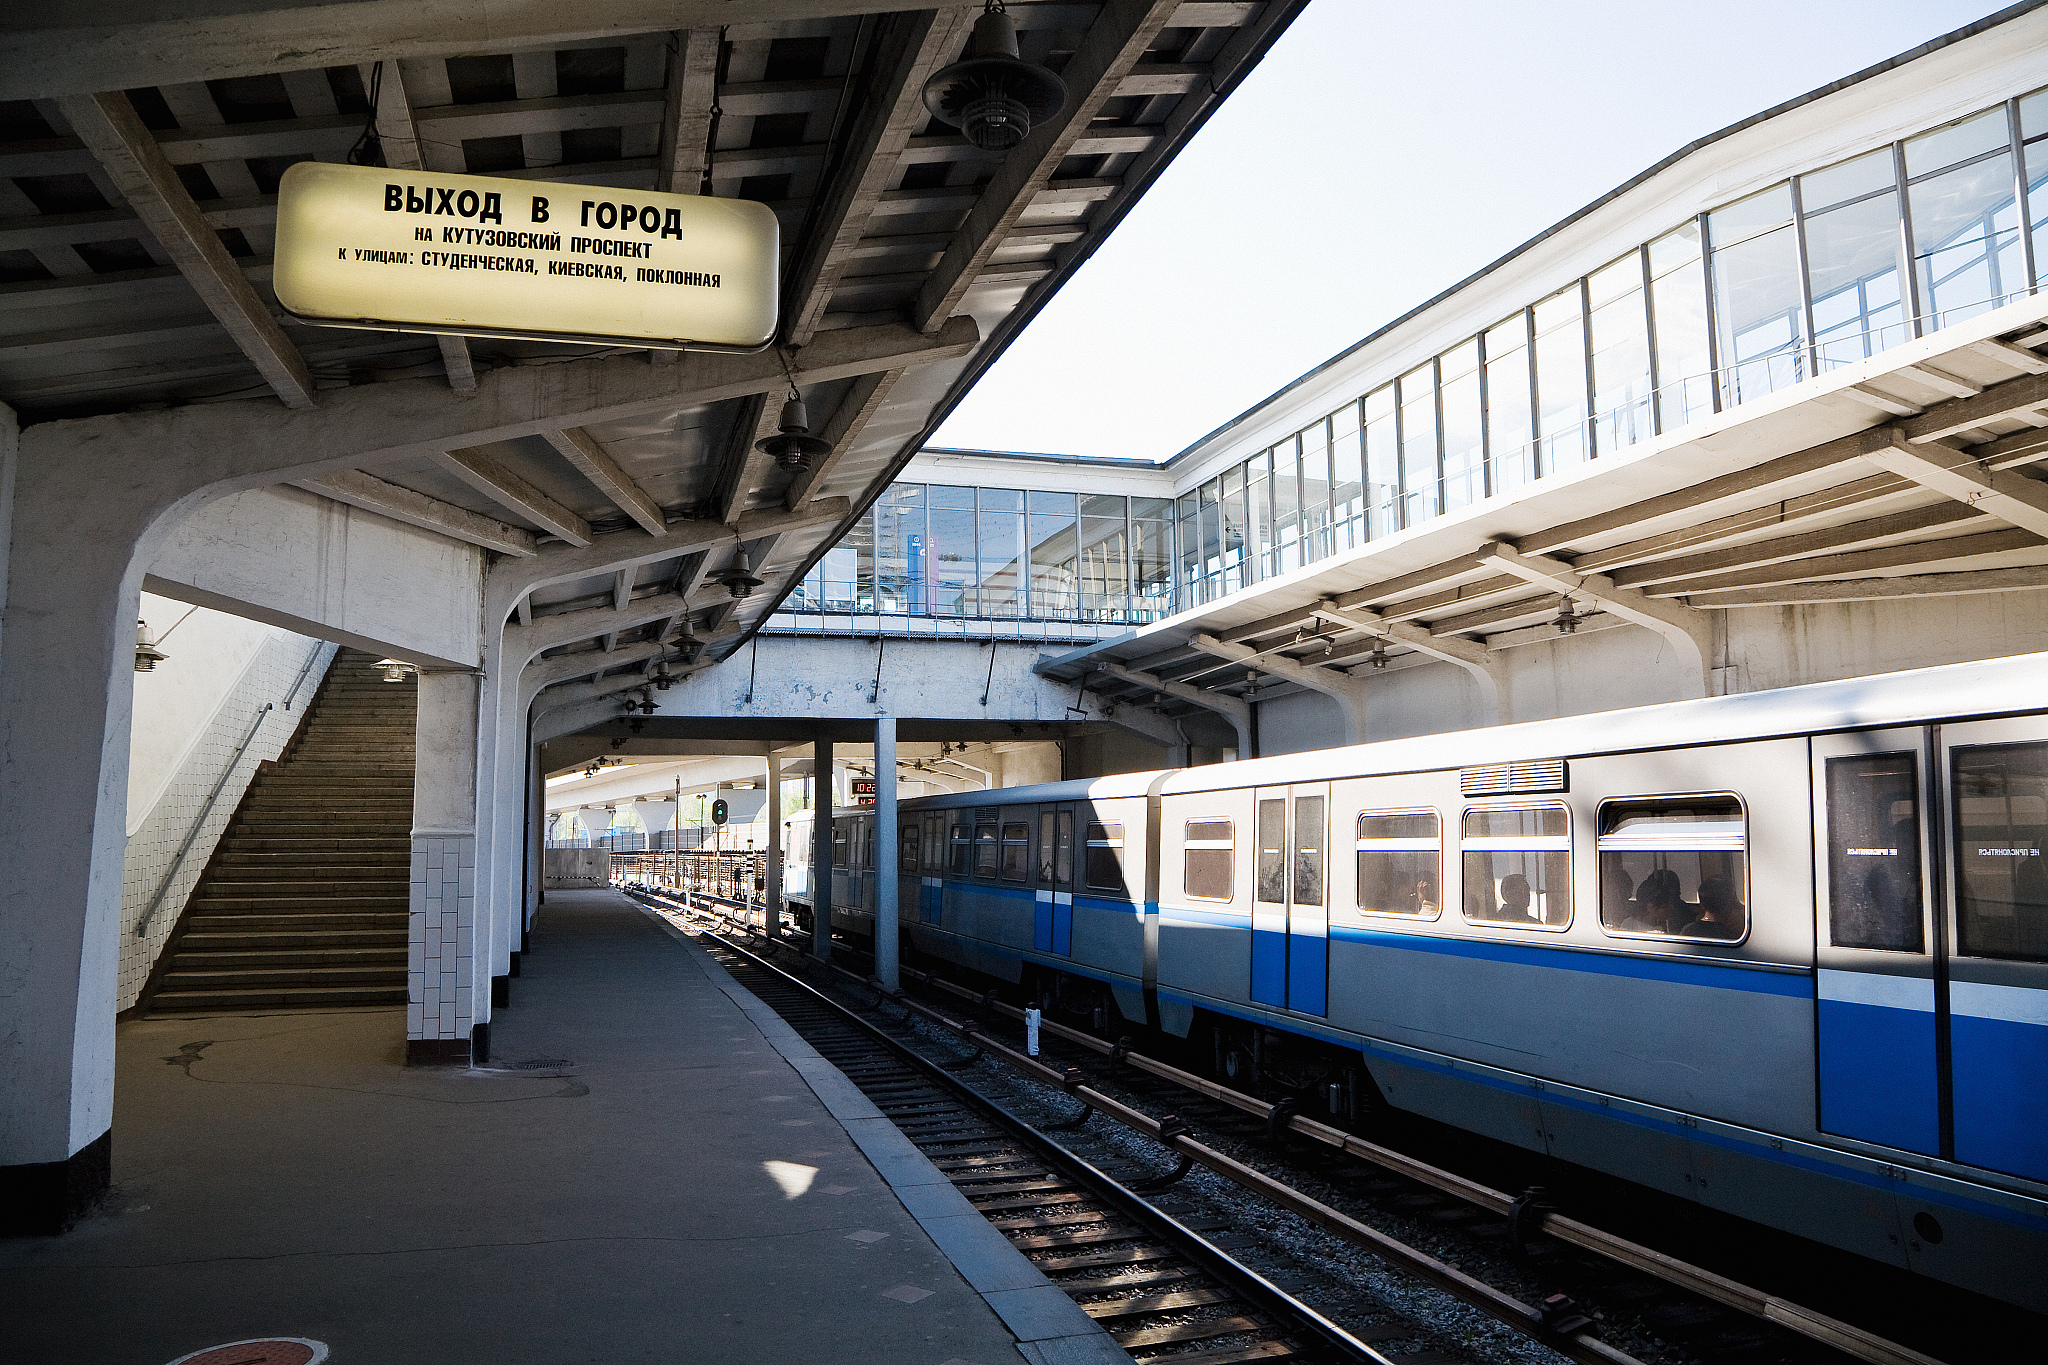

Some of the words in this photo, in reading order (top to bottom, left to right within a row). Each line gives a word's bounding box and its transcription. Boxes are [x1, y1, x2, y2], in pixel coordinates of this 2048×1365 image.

[384, 183, 503, 226] ВЫХОД
[531, 195, 550, 224] В
[580, 200, 683, 241] ГОРОД
[414, 227, 433, 242] НА
[442, 226, 561, 252] КУТУЗОВСКИЙ
[570, 236, 653, 259] ПРОСПЕКТ
[338, 247, 347, 260] К
[354, 248, 414, 264] УЛИЦАМ:
[421, 251, 539, 276] СТУДЕНЧЕСКАЯ,
[548, 260, 628, 283] КИЕВСКАЯ,
[636, 267, 721, 288] ПОКЛОННАЯ
